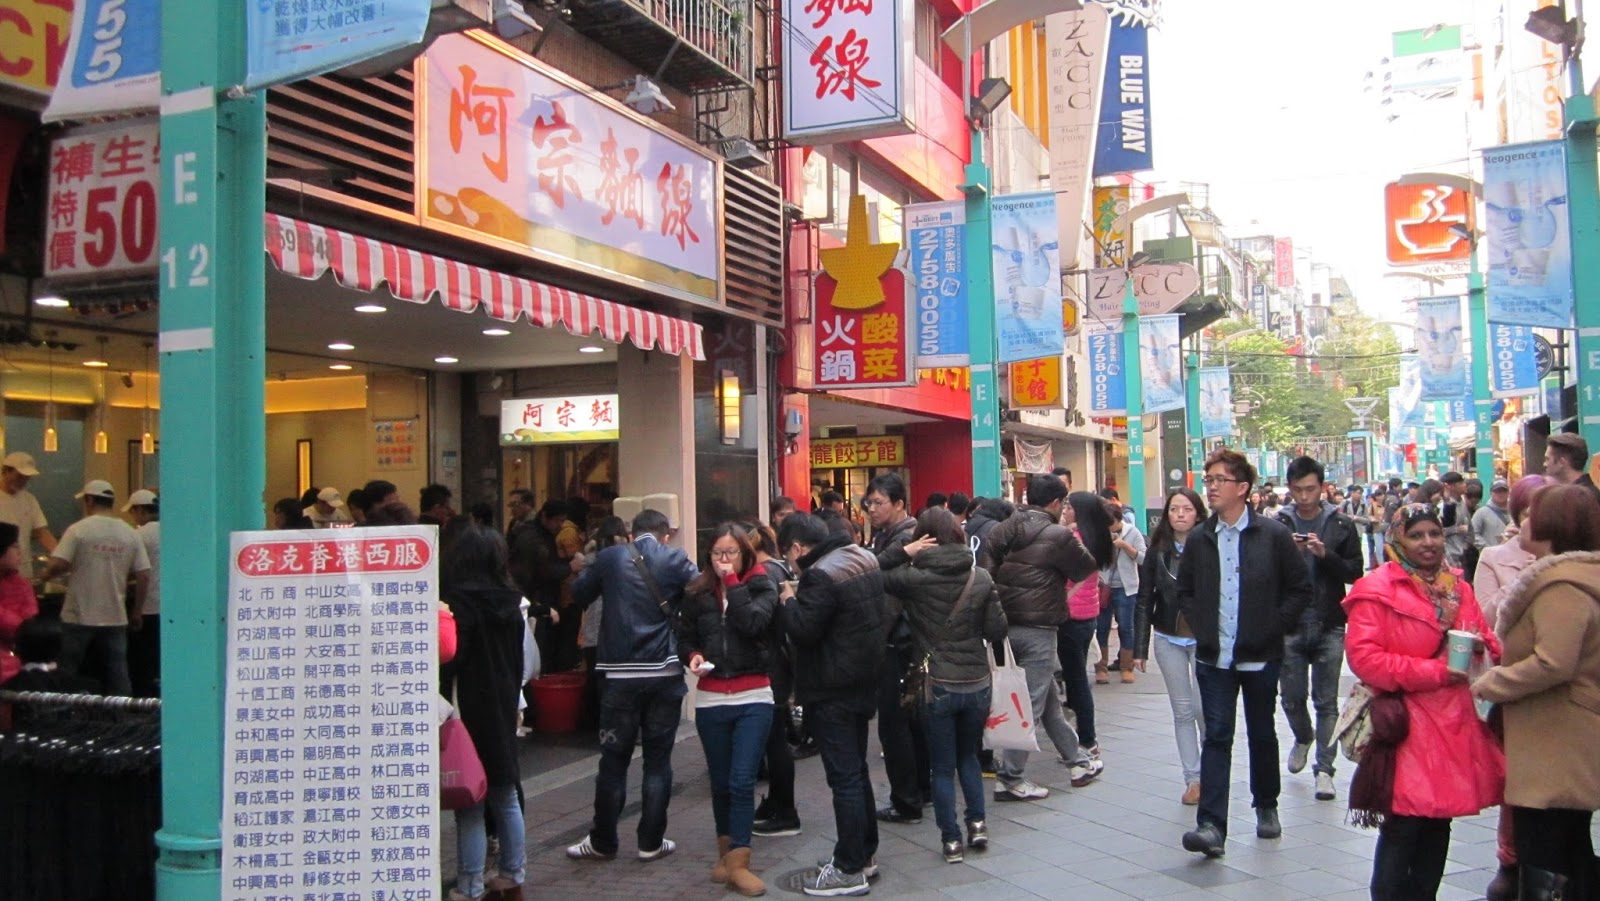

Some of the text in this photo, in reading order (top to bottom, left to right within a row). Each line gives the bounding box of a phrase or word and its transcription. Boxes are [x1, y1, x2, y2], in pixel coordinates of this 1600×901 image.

[1120, 55, 1146, 153] BLUE WAY
[449, 64, 700, 251] 阿宗麵線
[1484, 151, 1537, 165] Neogence
[174, 152, 197, 205] E
[992, 201, 1034, 212] Neogence
[84, 180, 157, 268] 50
[162, 243, 210, 289] 12
[820, 315, 856, 381] 火鍋
[861, 313, 898, 379] 酸菜
[976, 384, 986, 401] E
[523, 400, 613, 427] 阿宗麵
[973, 413, 993, 427] 14
[1480, 412, 1487, 424] E
[1131, 428, 1137, 438] E
[809, 441, 897, 464] 龍餃子館
[248, 542, 422, 571] 洛克香港西服
[305, 585, 360, 598] 中山女高
[372, 581, 428, 596] 建國中學
[238, 601, 428, 620] 師大附中 北商學院 板橋高中
[306, 624, 360, 637] 東山高中
[371, 621, 428, 635] 延平高中
[305, 644, 360, 658] 大安高工
[372, 641, 428, 655] 新店高中
[238, 667, 295, 680] 松山高中
[305, 664, 360, 678] 開平高中
[237, 681, 428, 700] 十信工商 祐德高中 北一女中
[304, 704, 360, 719] 成功高中
[371, 701, 428, 716] 松山高中
[236, 722, 429, 742] 中和高中 大同高中 華江高中
[236, 743, 429, 763] 再興高中 陽明高中 成淵高中
[304, 766, 360, 780] 中正高中
[371, 763, 429, 777] 林口高中
[371, 783, 429, 799] 協和工商
[234, 811, 294, 826] 稻江護家
[371, 805, 429, 820] 文德女中
[303, 829, 360, 843] 政大附中
[371, 825, 429, 840] 稻江高商
[233, 875, 293, 889] 中興高中
[372, 868, 430, 882] 大理高中
